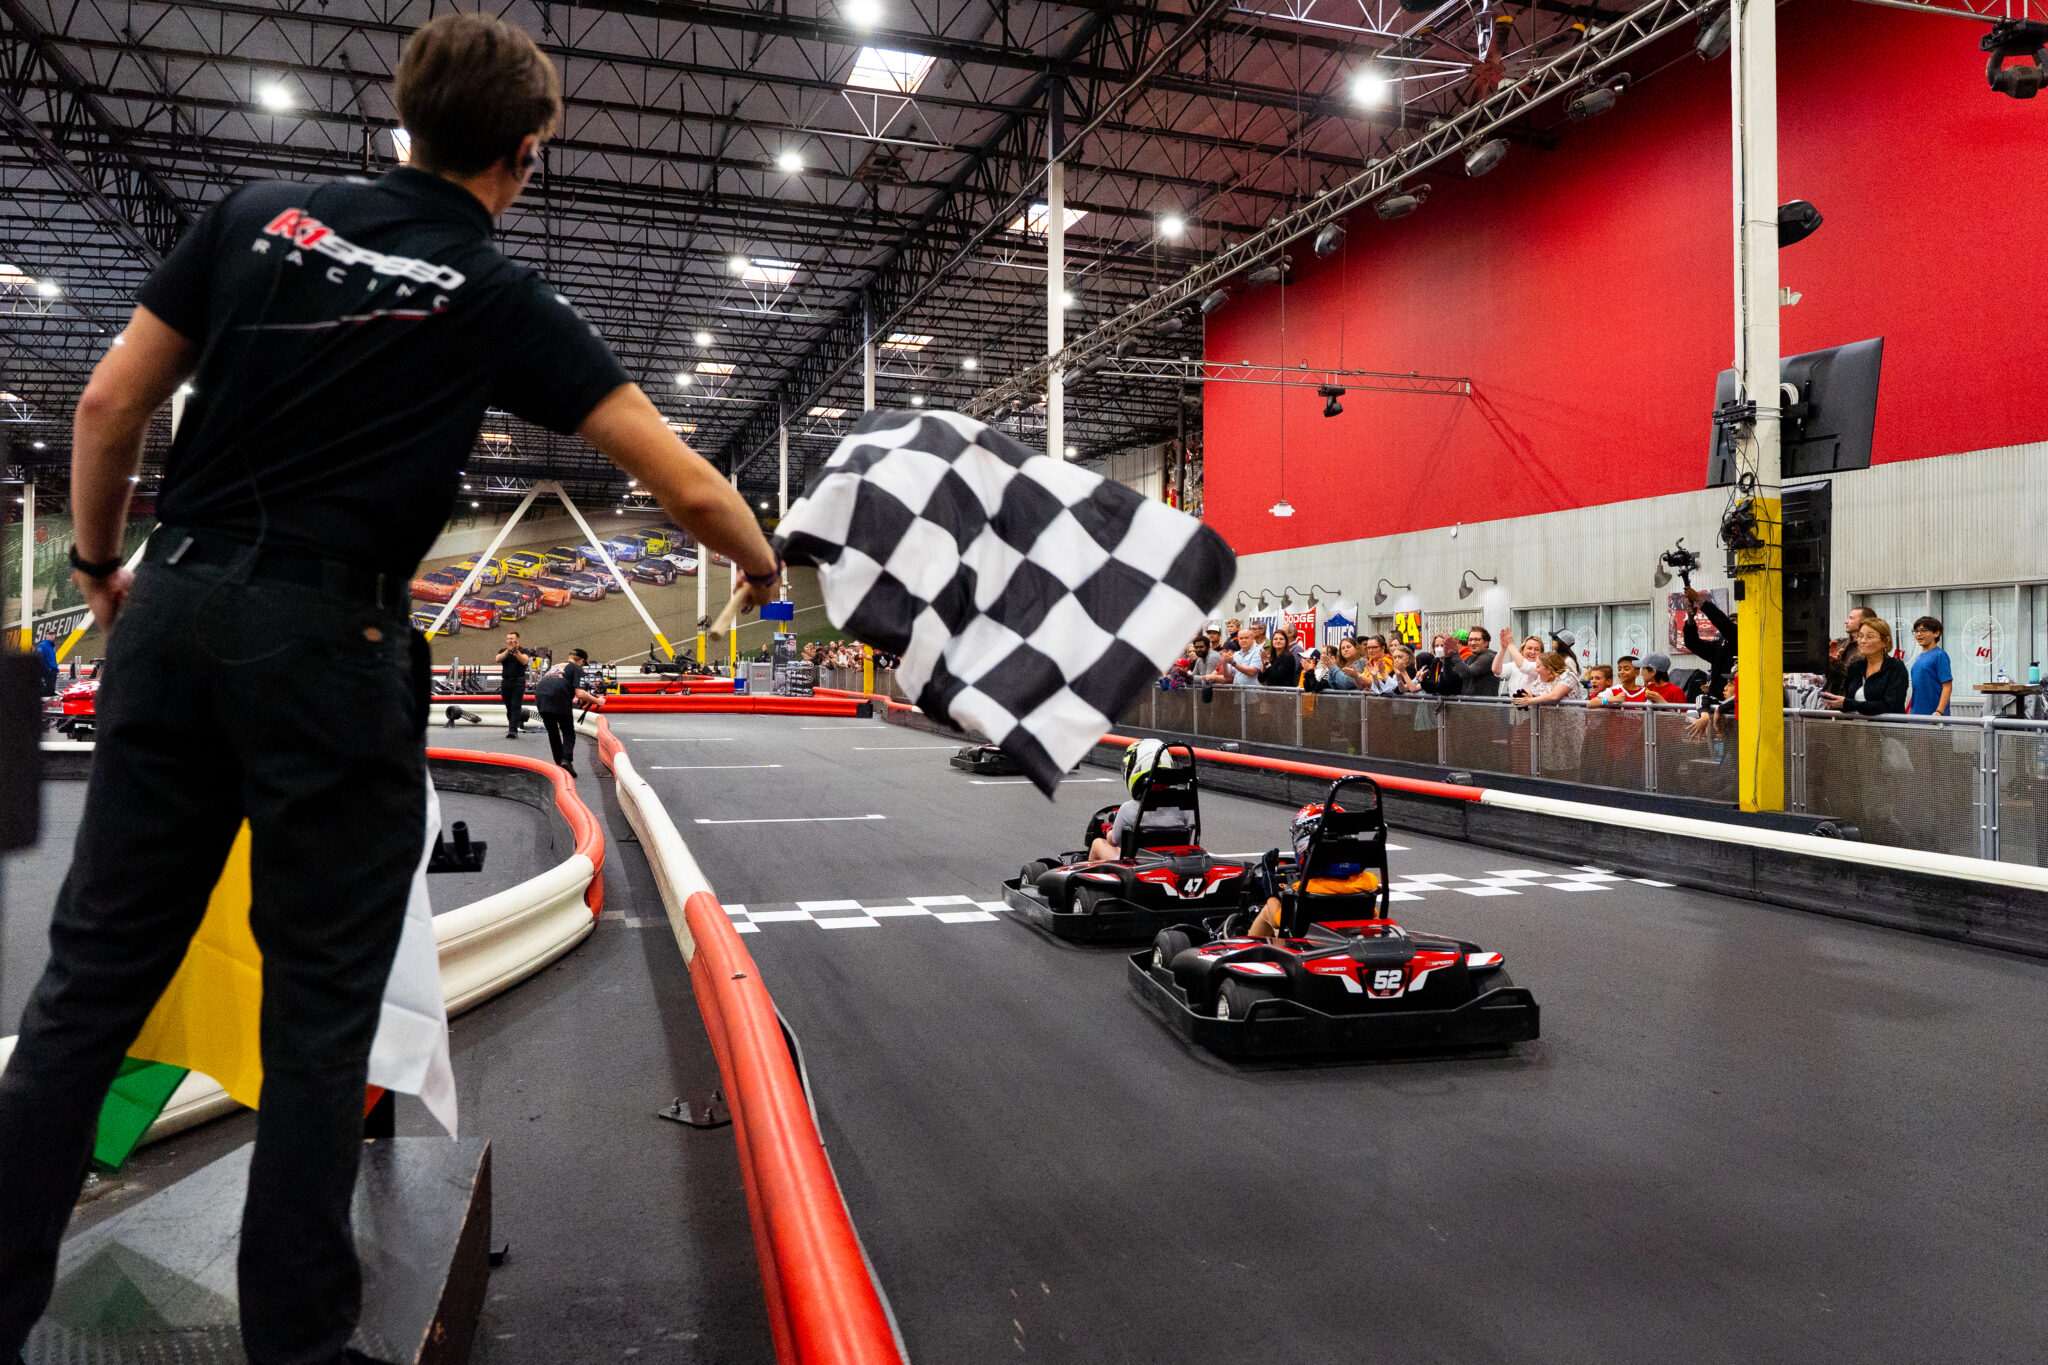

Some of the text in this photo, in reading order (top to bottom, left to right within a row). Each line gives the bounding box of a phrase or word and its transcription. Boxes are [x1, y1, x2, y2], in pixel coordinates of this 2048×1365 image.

[1284, 613, 1315, 623] DODGE
[1184, 878, 1203, 893] 47
[1373, 969, 1403, 990] 52
